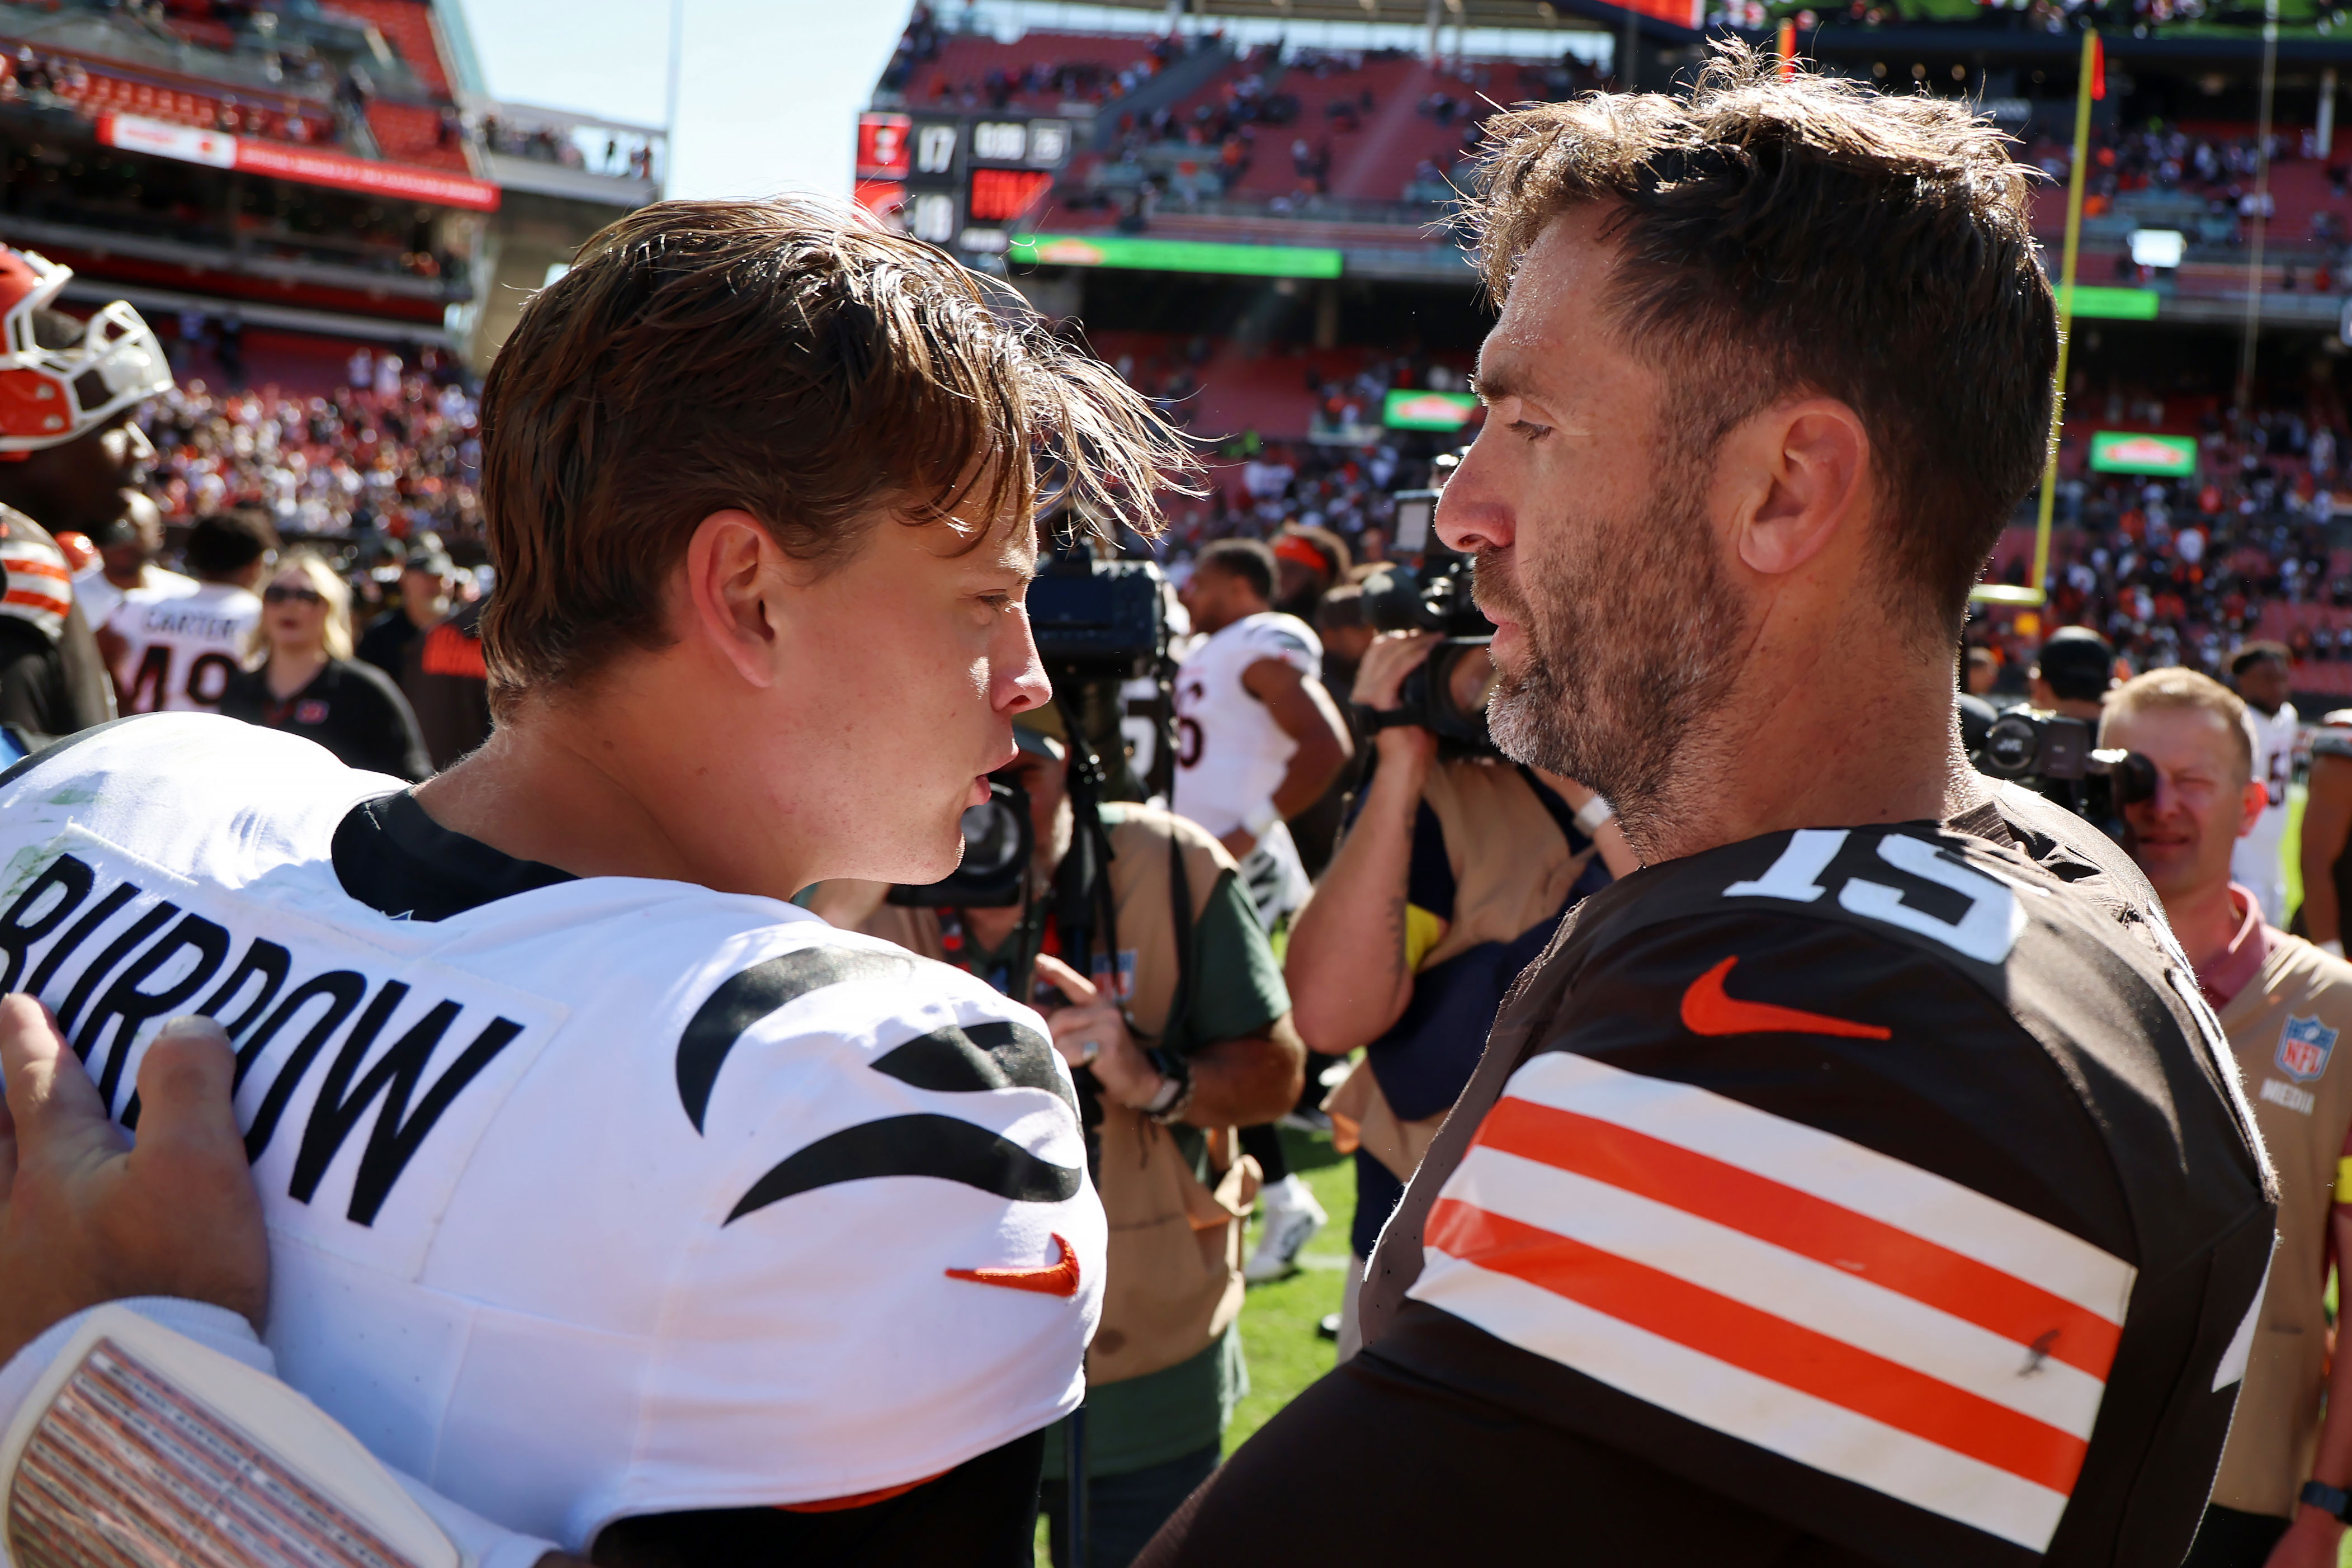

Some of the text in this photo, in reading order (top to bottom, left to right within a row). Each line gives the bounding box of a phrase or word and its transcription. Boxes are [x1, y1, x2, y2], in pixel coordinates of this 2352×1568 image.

[1996, 738, 2023, 752] JVC
[1722, 829, 2027, 965] 15
[2260, 1077, 2315, 1117] MEDIA
